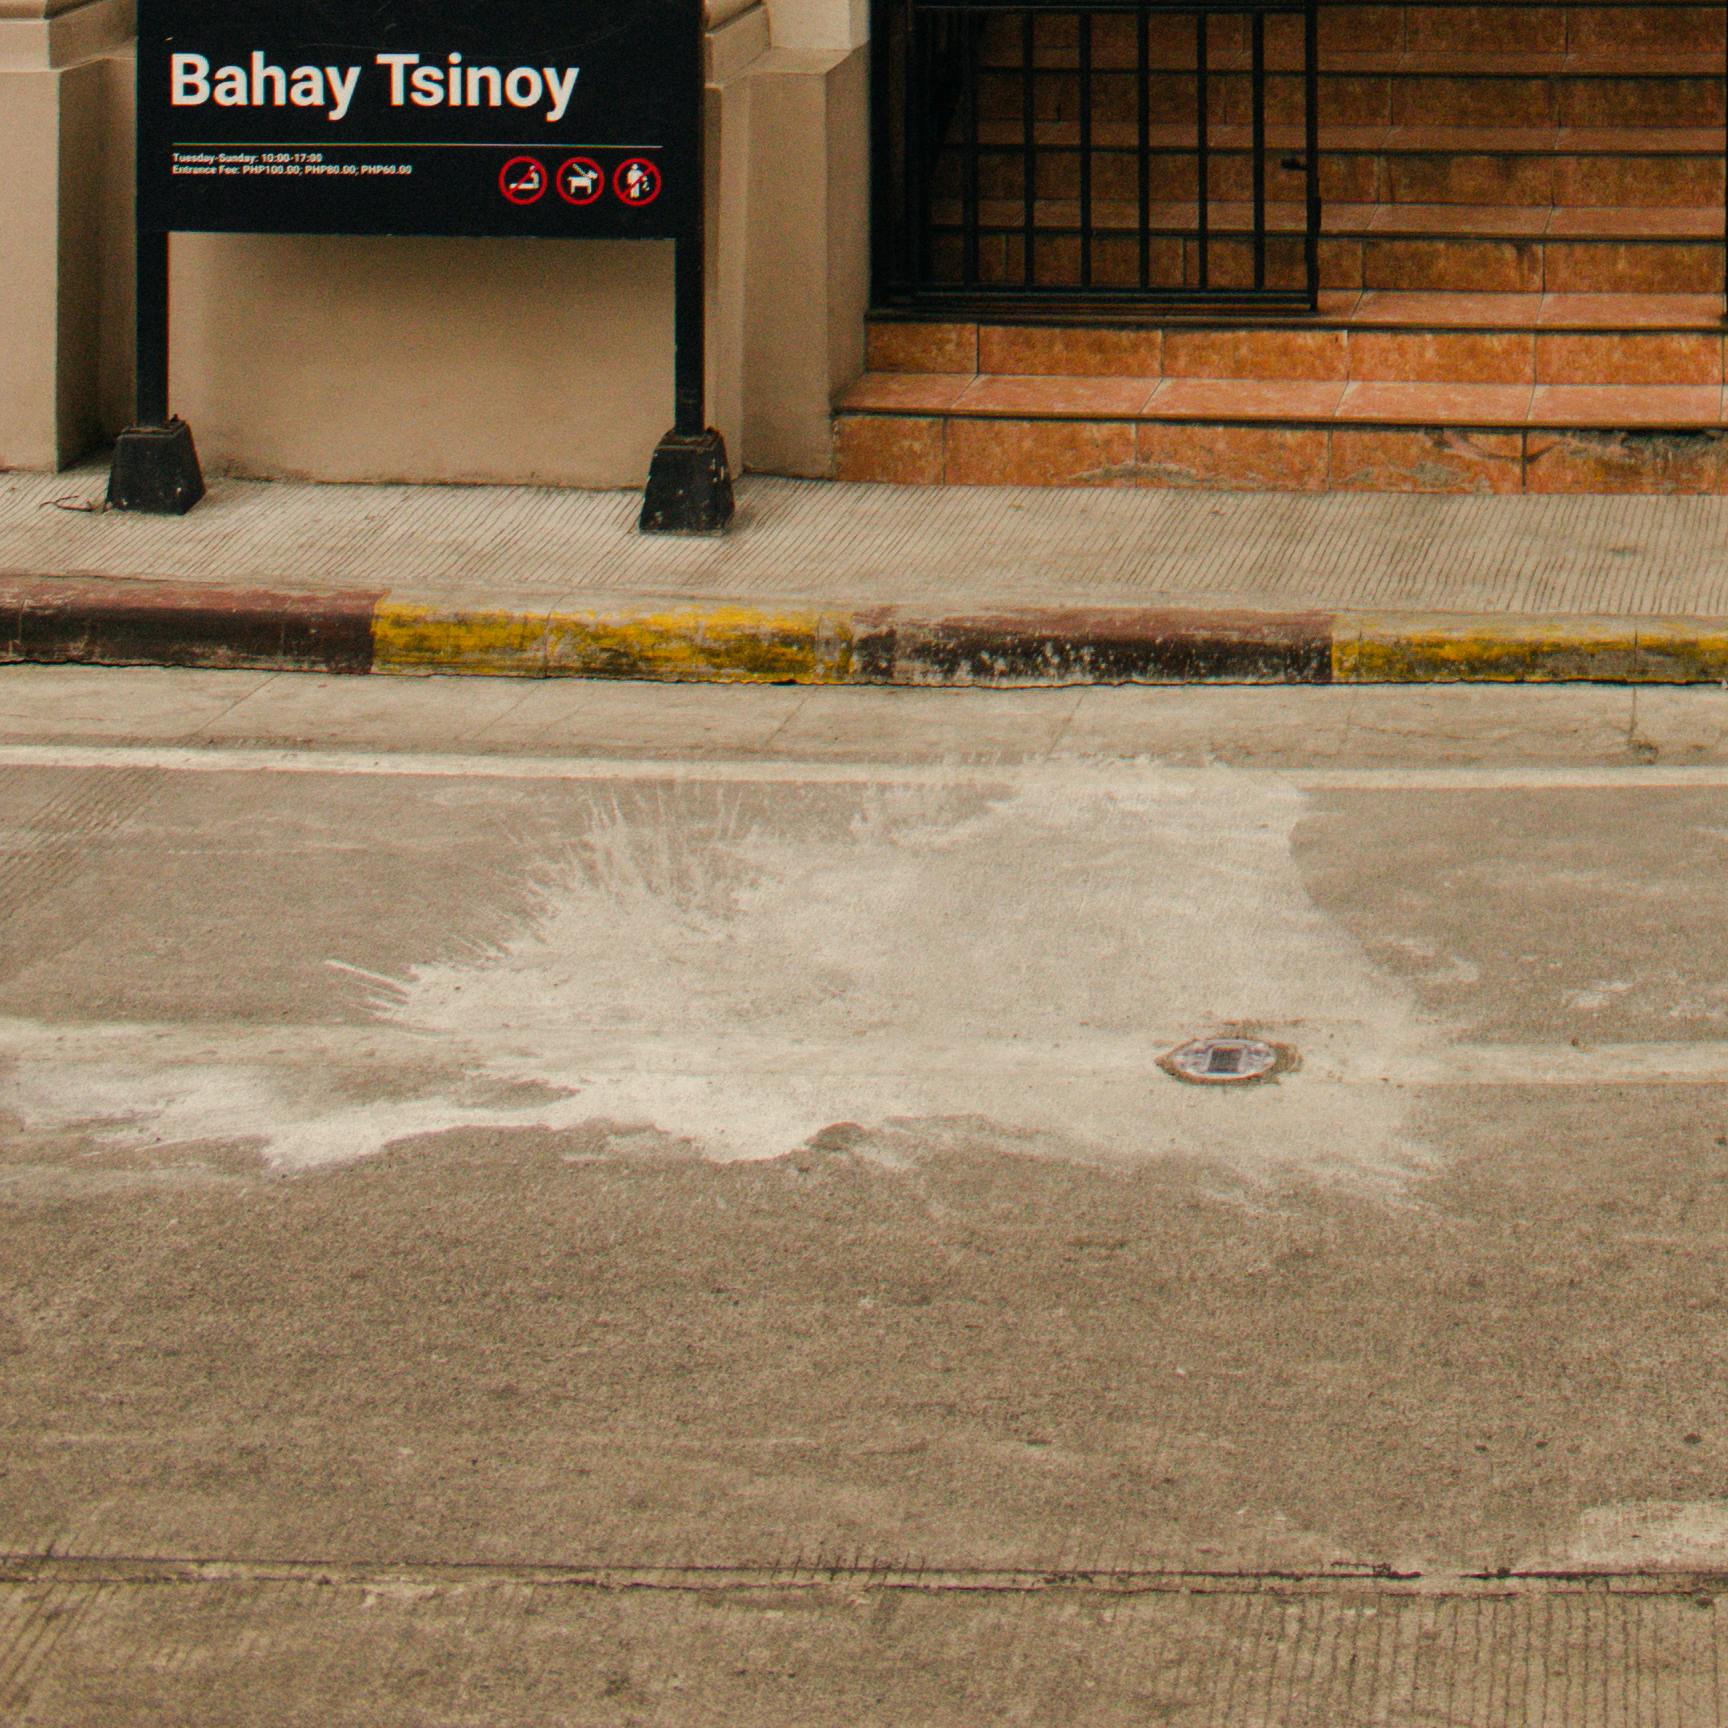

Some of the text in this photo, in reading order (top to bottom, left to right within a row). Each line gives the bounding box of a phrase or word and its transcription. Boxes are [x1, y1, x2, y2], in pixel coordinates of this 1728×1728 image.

[170, 51, 579, 122] Bahay Tsinoy
[172, 165, 217, 175] Entrance
